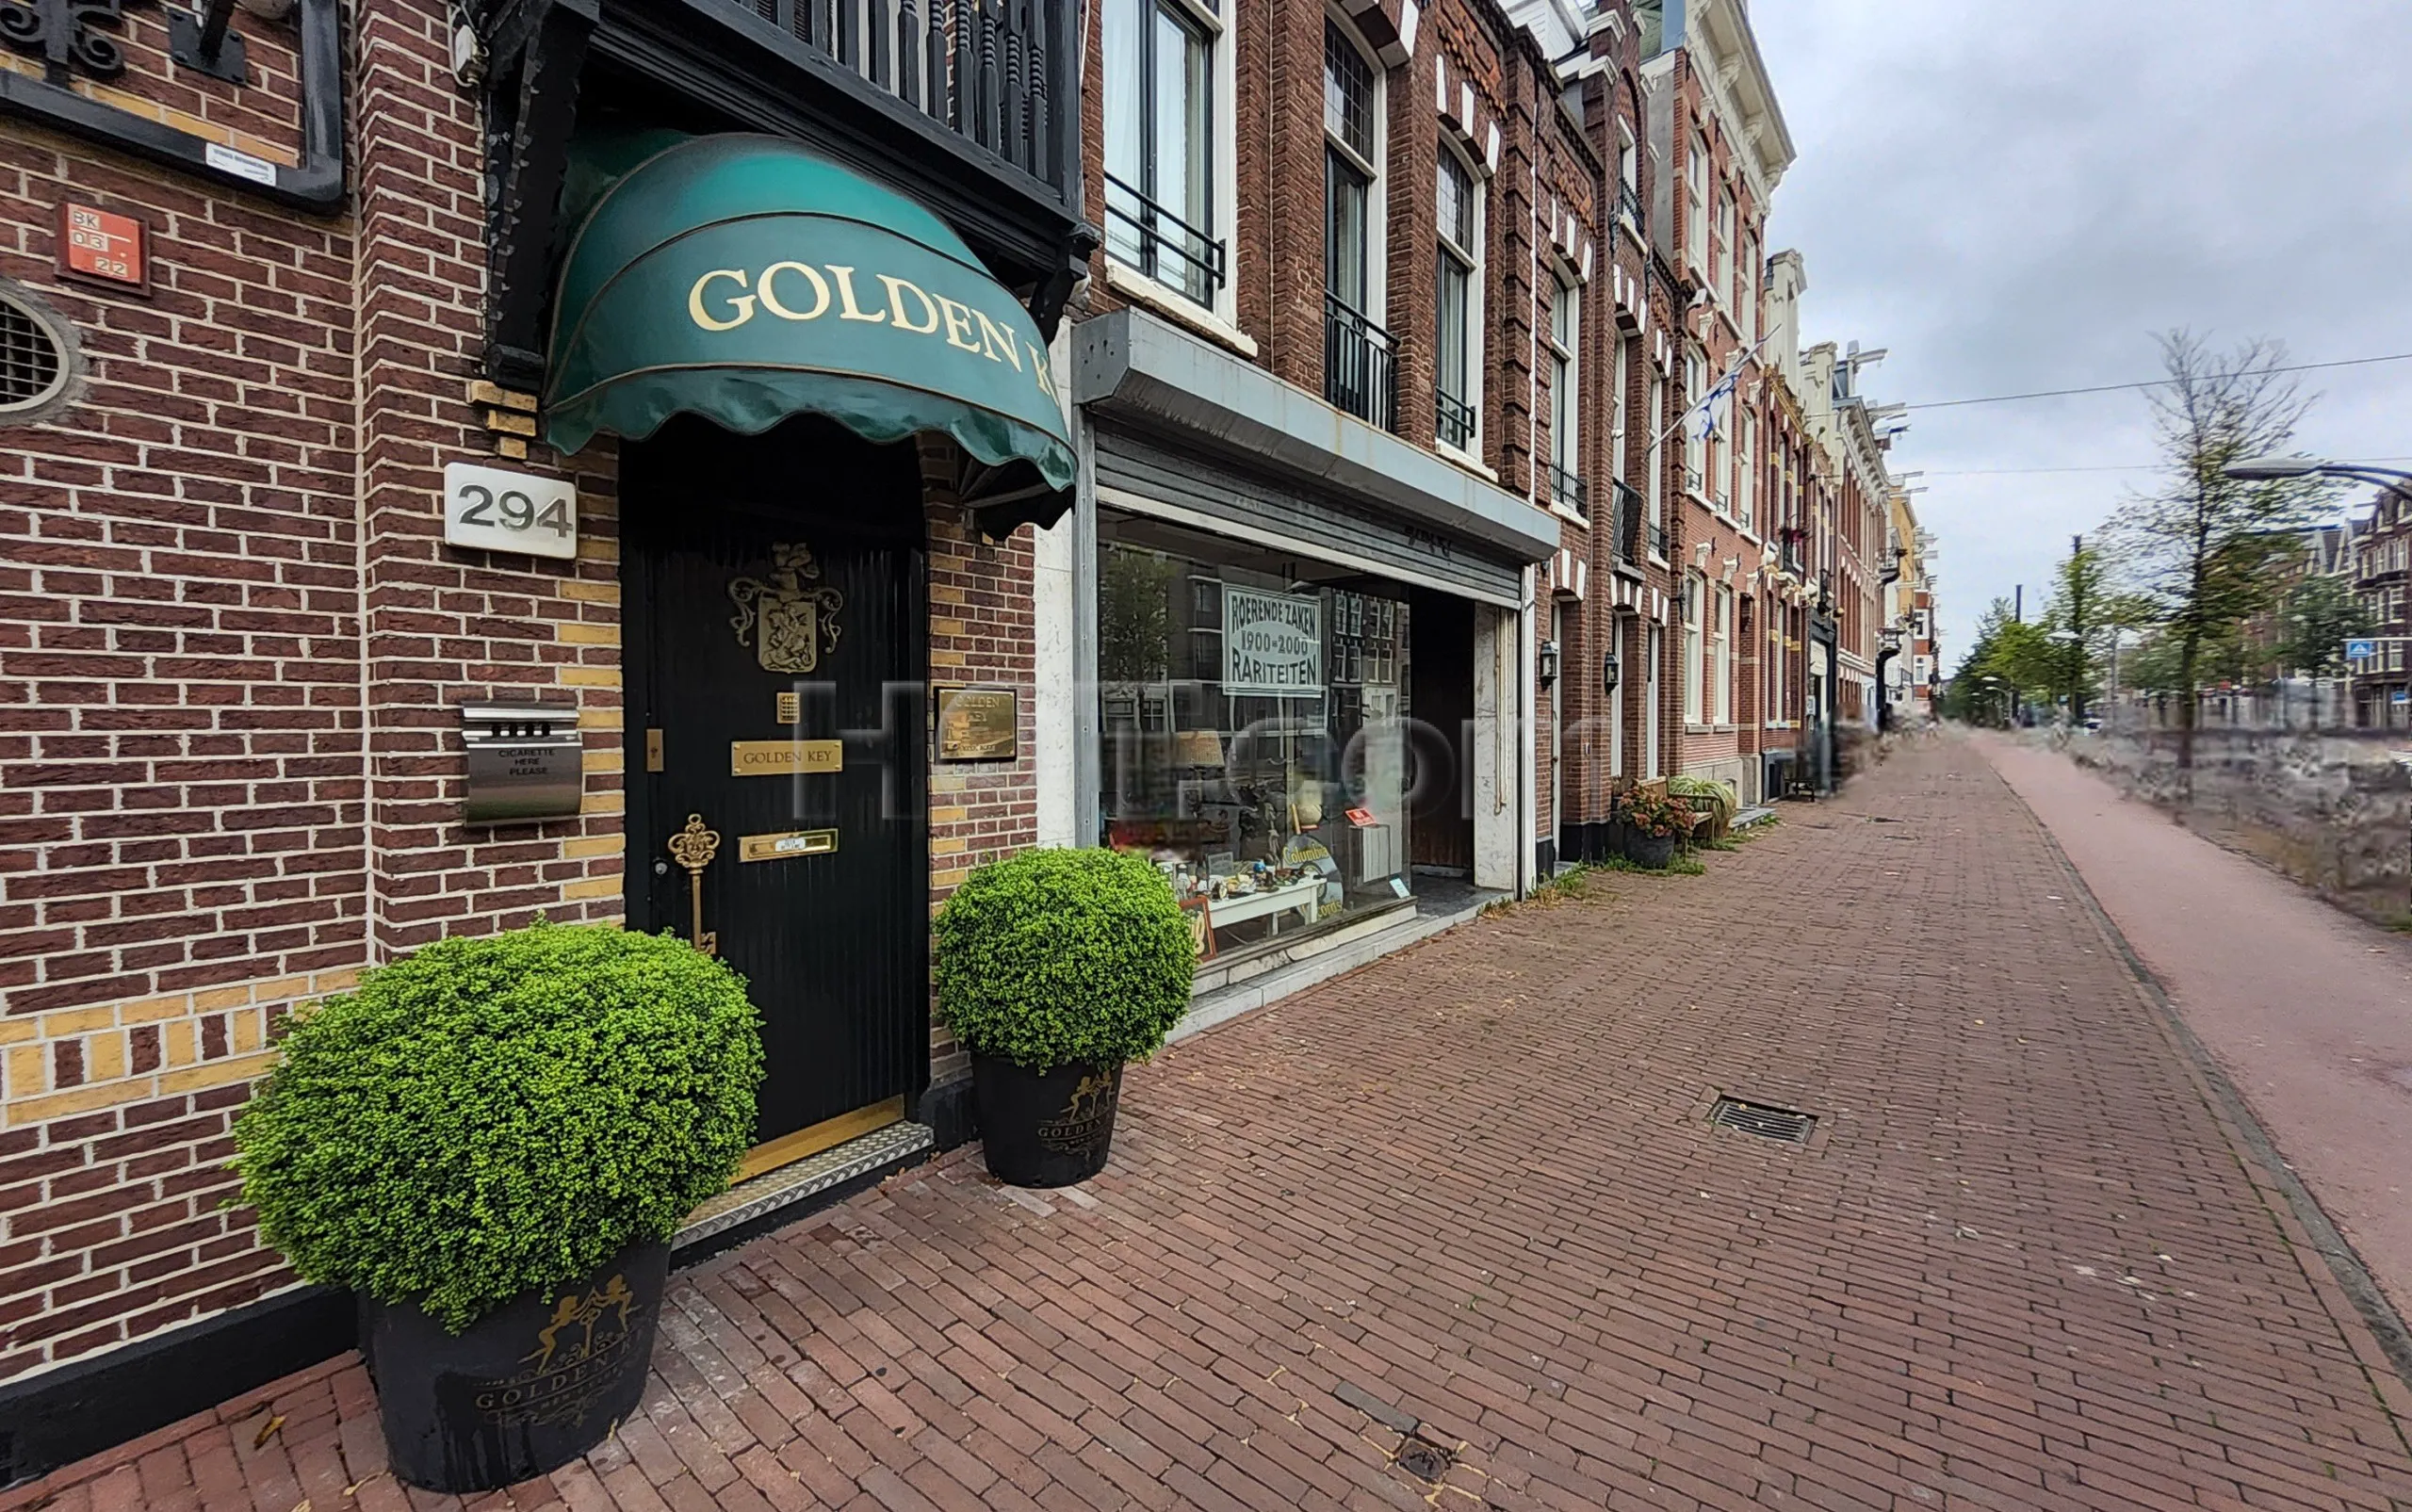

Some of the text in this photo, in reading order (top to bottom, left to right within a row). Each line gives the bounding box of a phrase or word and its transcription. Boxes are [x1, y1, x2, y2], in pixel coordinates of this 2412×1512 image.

[689, 261, 1022, 373] GOLDEN
[459, 482, 574, 538] 294
[1231, 594, 1316, 642] ROERENDE ZAKEN
[1241, 630, 1309, 657] 1900-2000
[1231, 646, 1317, 686] RARITEITEN
[510, 767, 547, 775] PLEASE
[514, 757, 540, 766] HERE
[743, 750, 834, 764] GOLDEN KEY
[1282, 843, 1329, 866] Columbia
[475, 1352, 608, 1409] GOLDEN
